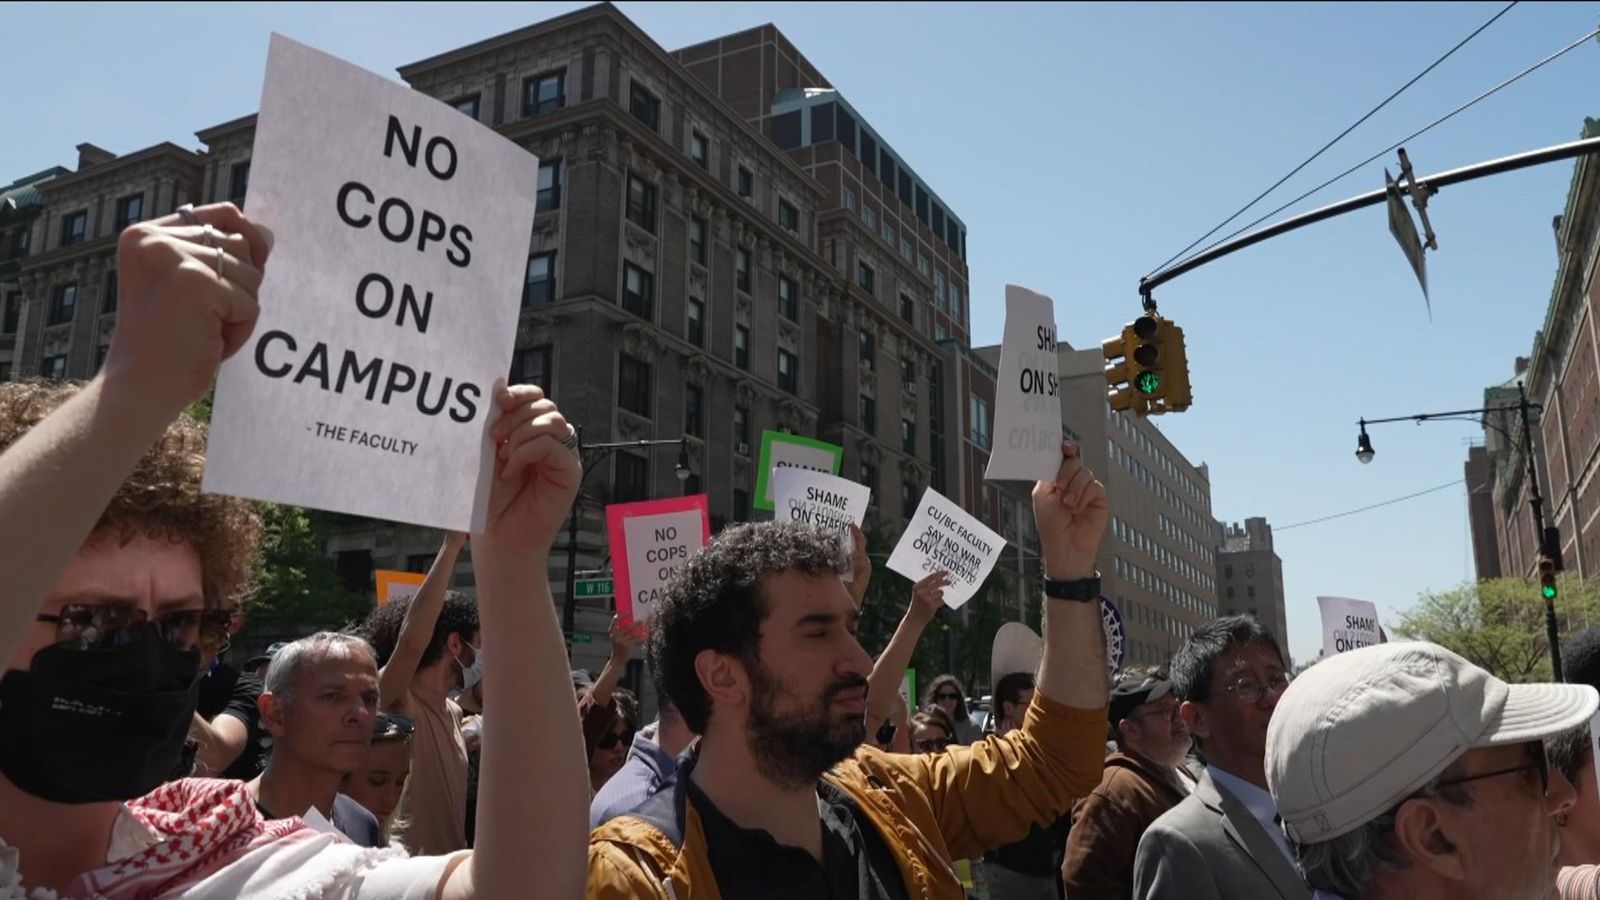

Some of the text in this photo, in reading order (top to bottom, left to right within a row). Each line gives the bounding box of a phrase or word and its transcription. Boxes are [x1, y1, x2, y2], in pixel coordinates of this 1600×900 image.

[384, 114, 458, 181] NO
[336, 181, 473, 268] COPS
[355, 272, 434, 334] ON
[254, 330, 481, 423] CAMPUS
[1020, 368, 1044, 395] ON
[316, 421, 348, 441] THE
[349, 430, 419, 456] FACULTY
[807, 486, 849, 511] SHAME
[791, 507, 812, 524] ON
[655, 527, 677, 542] NO
[928, 505, 993, 557] CU/BC FACULTY
[646, 545, 687, 563] COPS
[913, 538, 932, 555] ON
[928, 525, 981, 568] SAY NO WAR
[586, 582, 610, 594] W 116
[1336, 638, 1353, 653] ON
